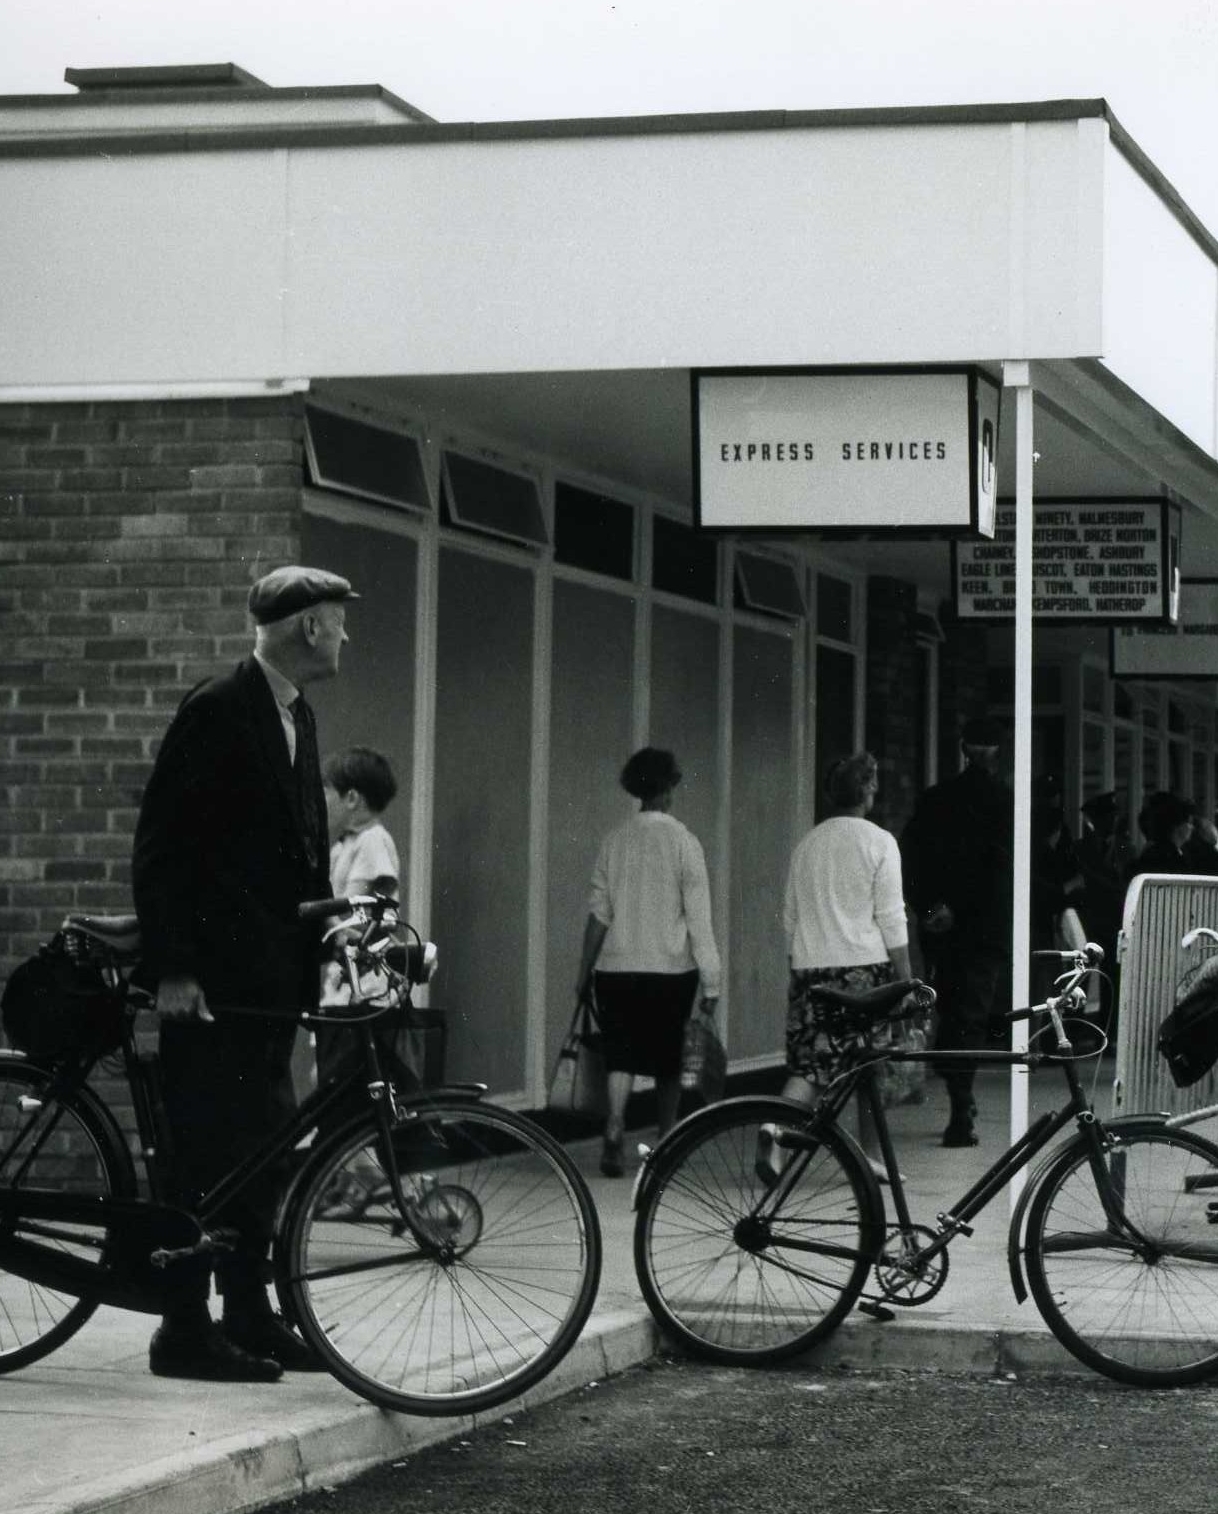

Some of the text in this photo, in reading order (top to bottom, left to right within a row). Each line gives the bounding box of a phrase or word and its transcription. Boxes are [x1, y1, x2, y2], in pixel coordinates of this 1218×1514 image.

[720, 441, 946, 462] EXPRESS SERVICES
[1108, 563, 1157, 577] HASTINGS
